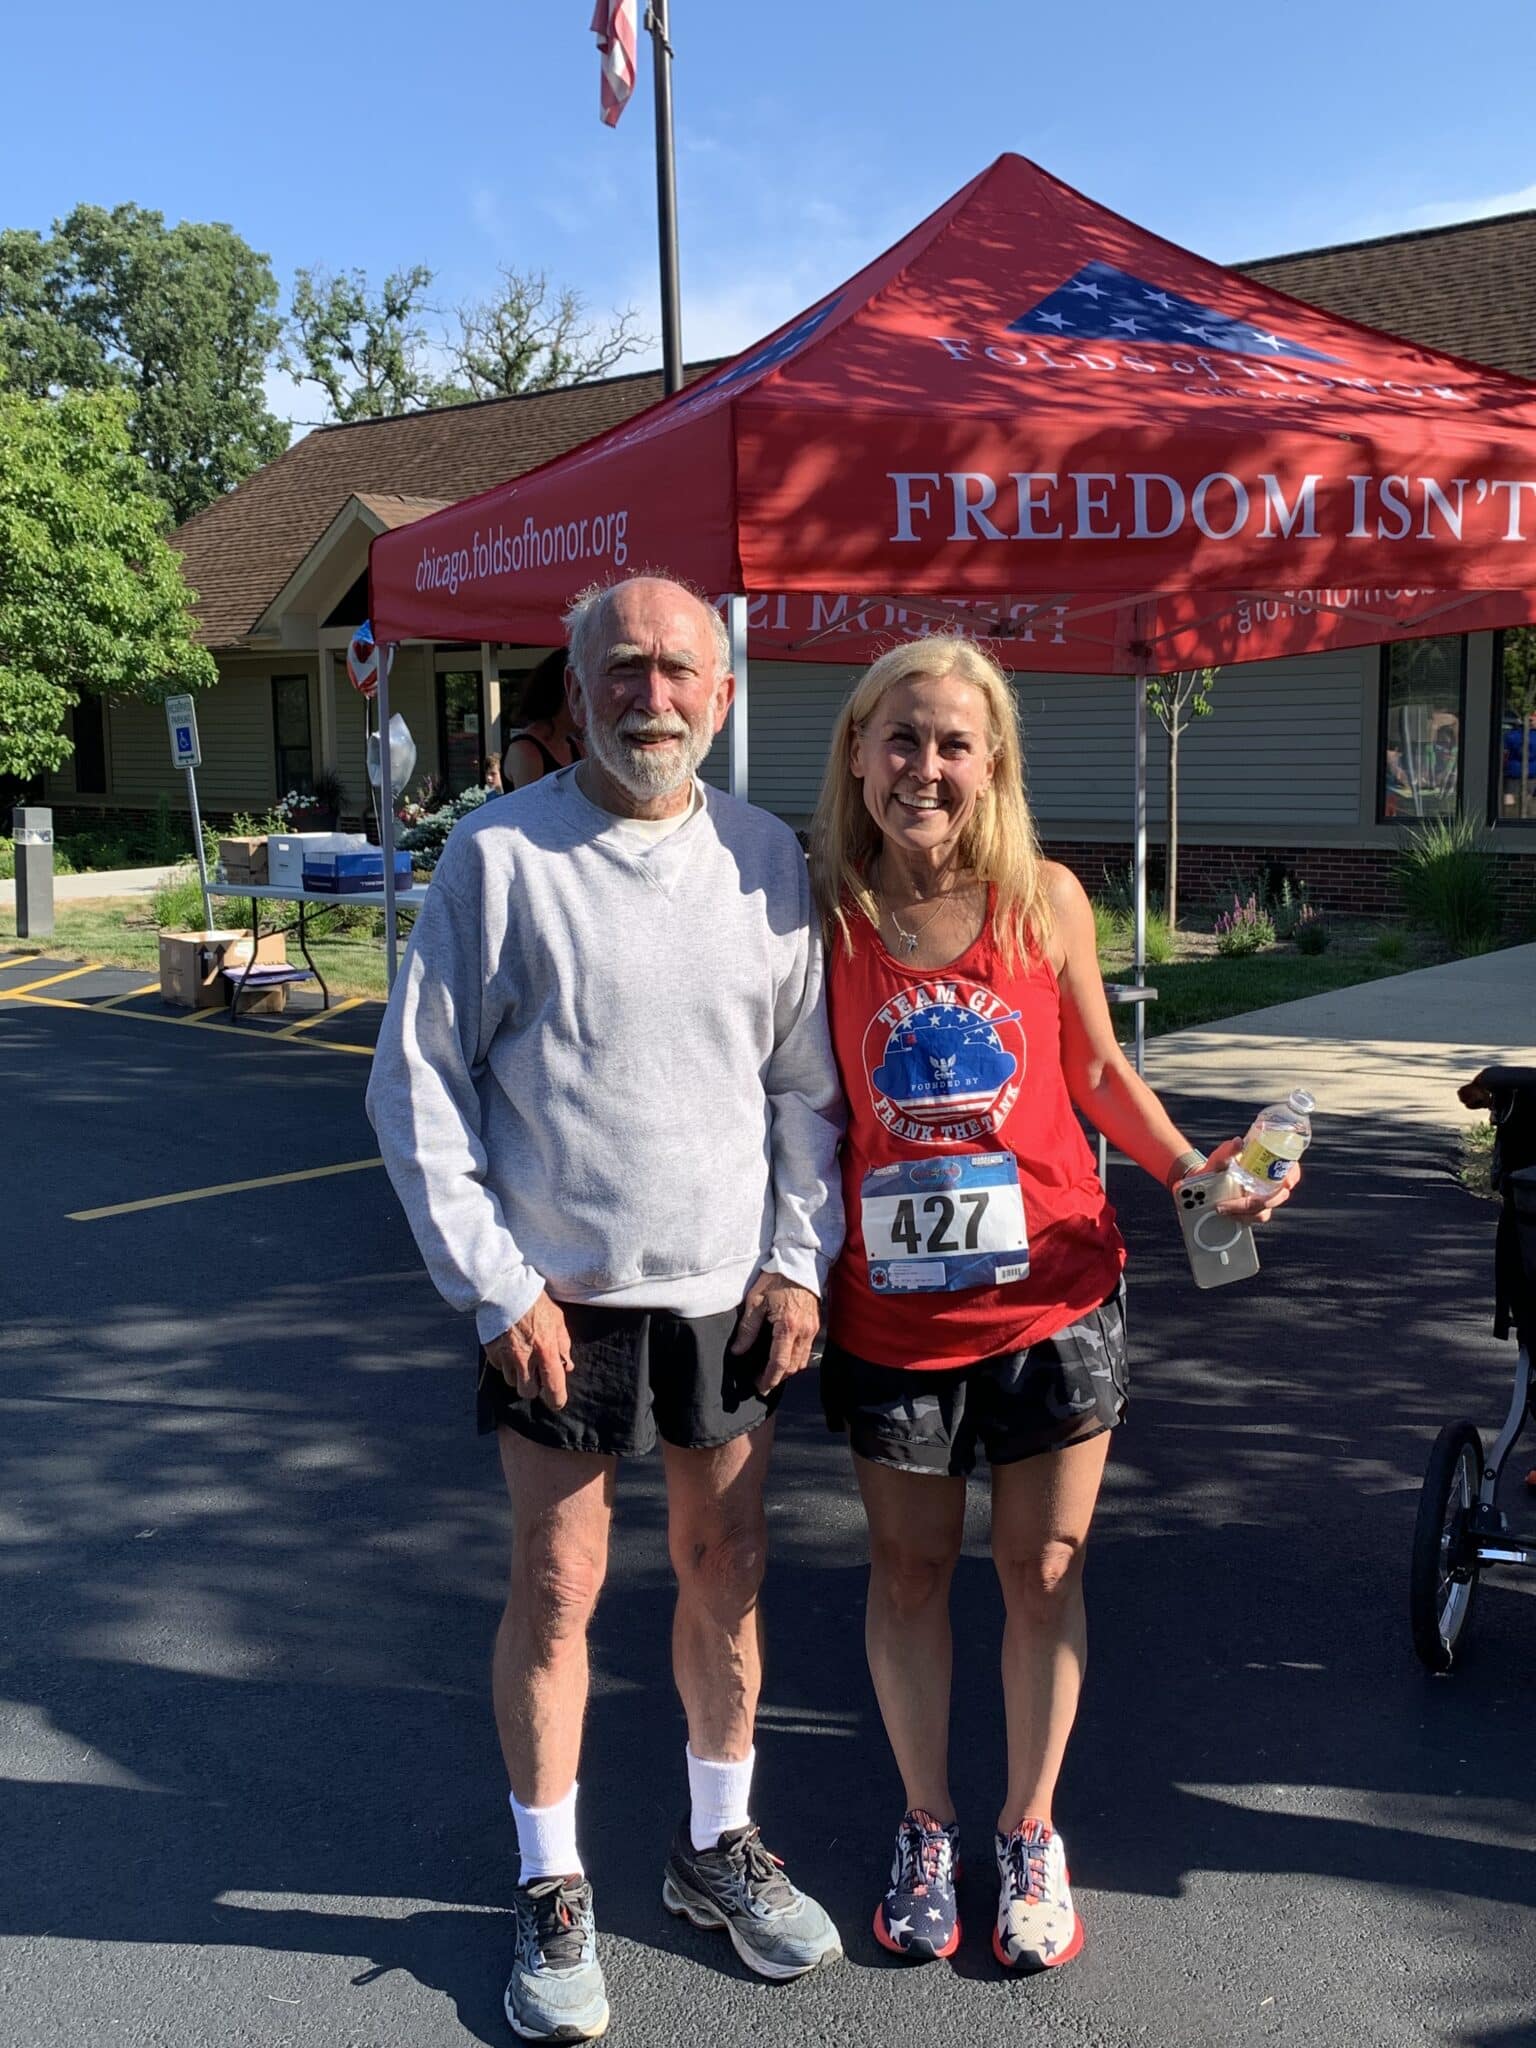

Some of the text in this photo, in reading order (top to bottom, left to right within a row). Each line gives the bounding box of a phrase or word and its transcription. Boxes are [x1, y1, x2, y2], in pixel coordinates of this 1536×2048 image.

[928, 336, 1156, 374] FOLDS
[1172, 356, 1221, 382] of
[886, 472, 1536, 542] FREEDOM ISN'T
[415, 509, 629, 595] chicago.foldsofhonor.org
[878, 984, 1002, 1029] TEAM GI
[874, 1082, 1020, 1140] FRANK THE TANK
[911, 1076, 979, 1091] FOUNDED BY
[890, 1191, 990, 1255] 427
